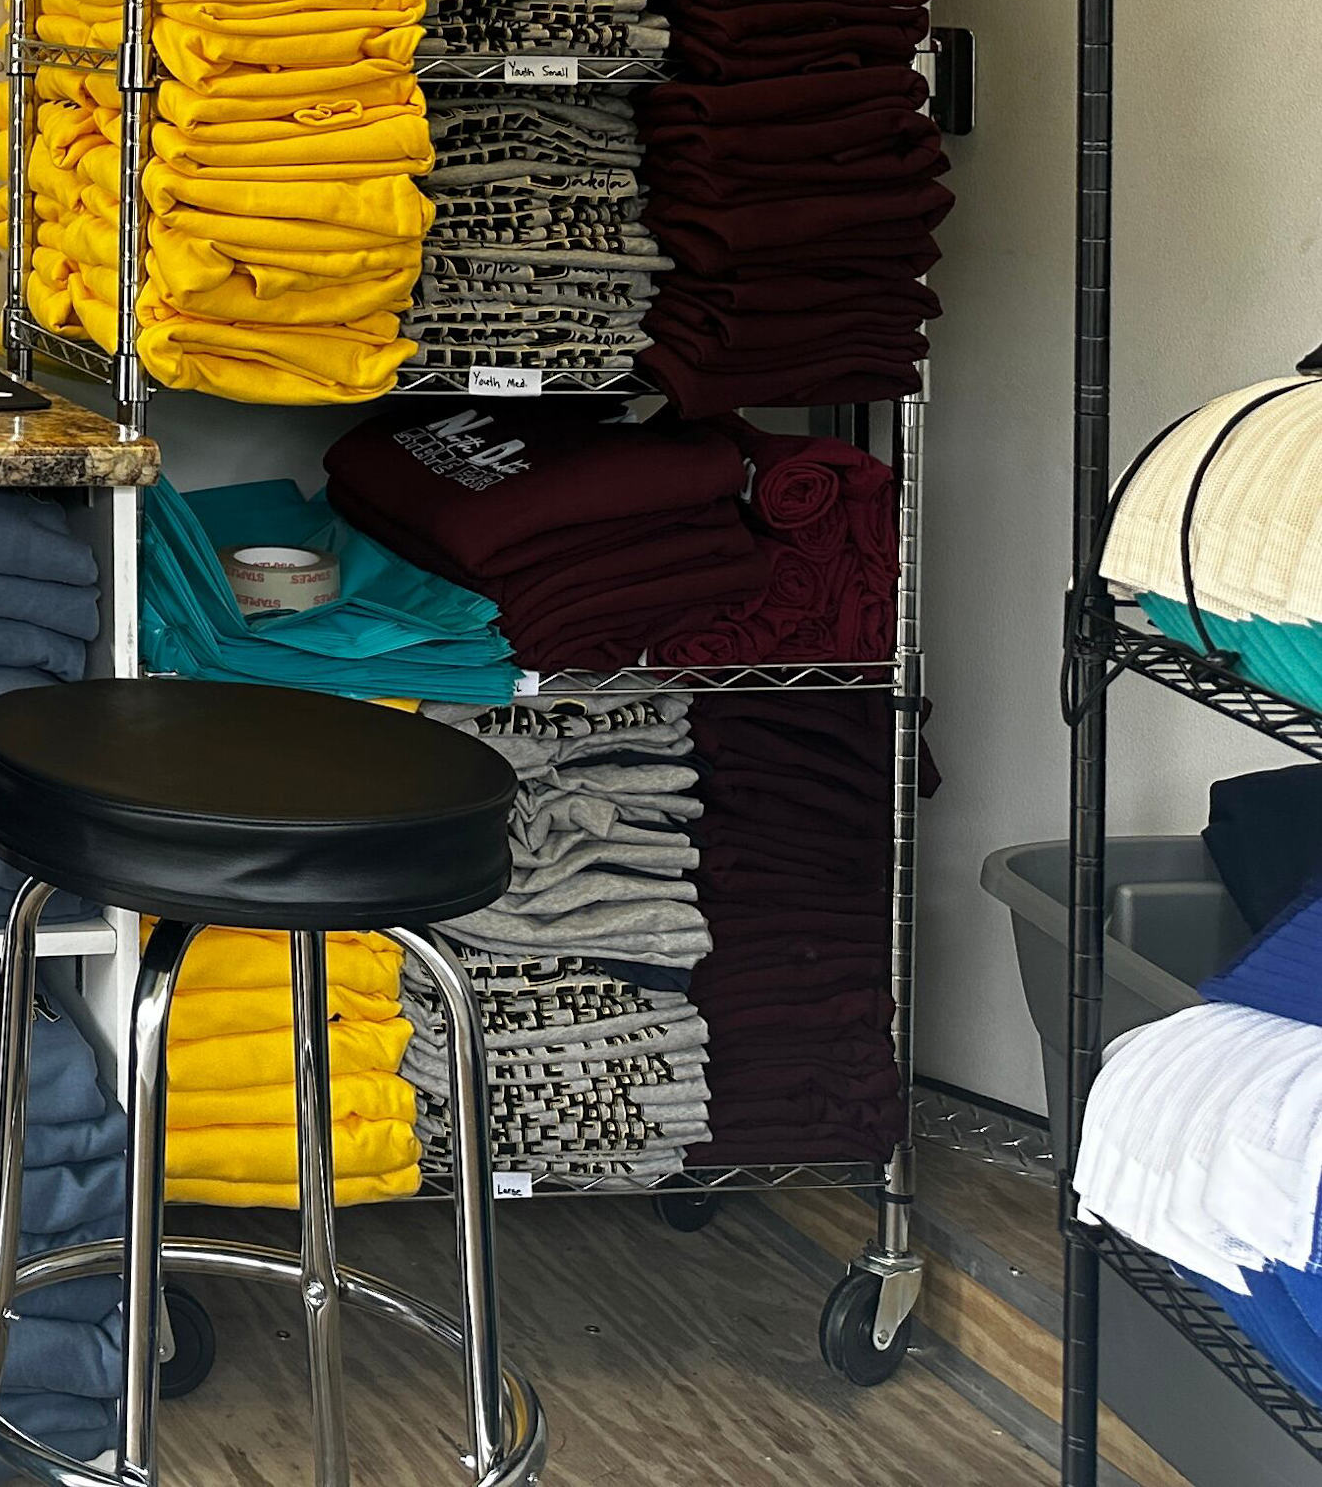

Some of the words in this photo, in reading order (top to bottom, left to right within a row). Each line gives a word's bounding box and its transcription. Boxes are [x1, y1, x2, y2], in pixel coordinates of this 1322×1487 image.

[508, 60, 535, 77] Youth
[541, 65, 568, 79] Small
[473, 371, 501, 389] Youth
[289, 570, 332, 585] STAPLES
[473, 705, 575, 739] STATE
[587, 700, 668, 734] FAIR
